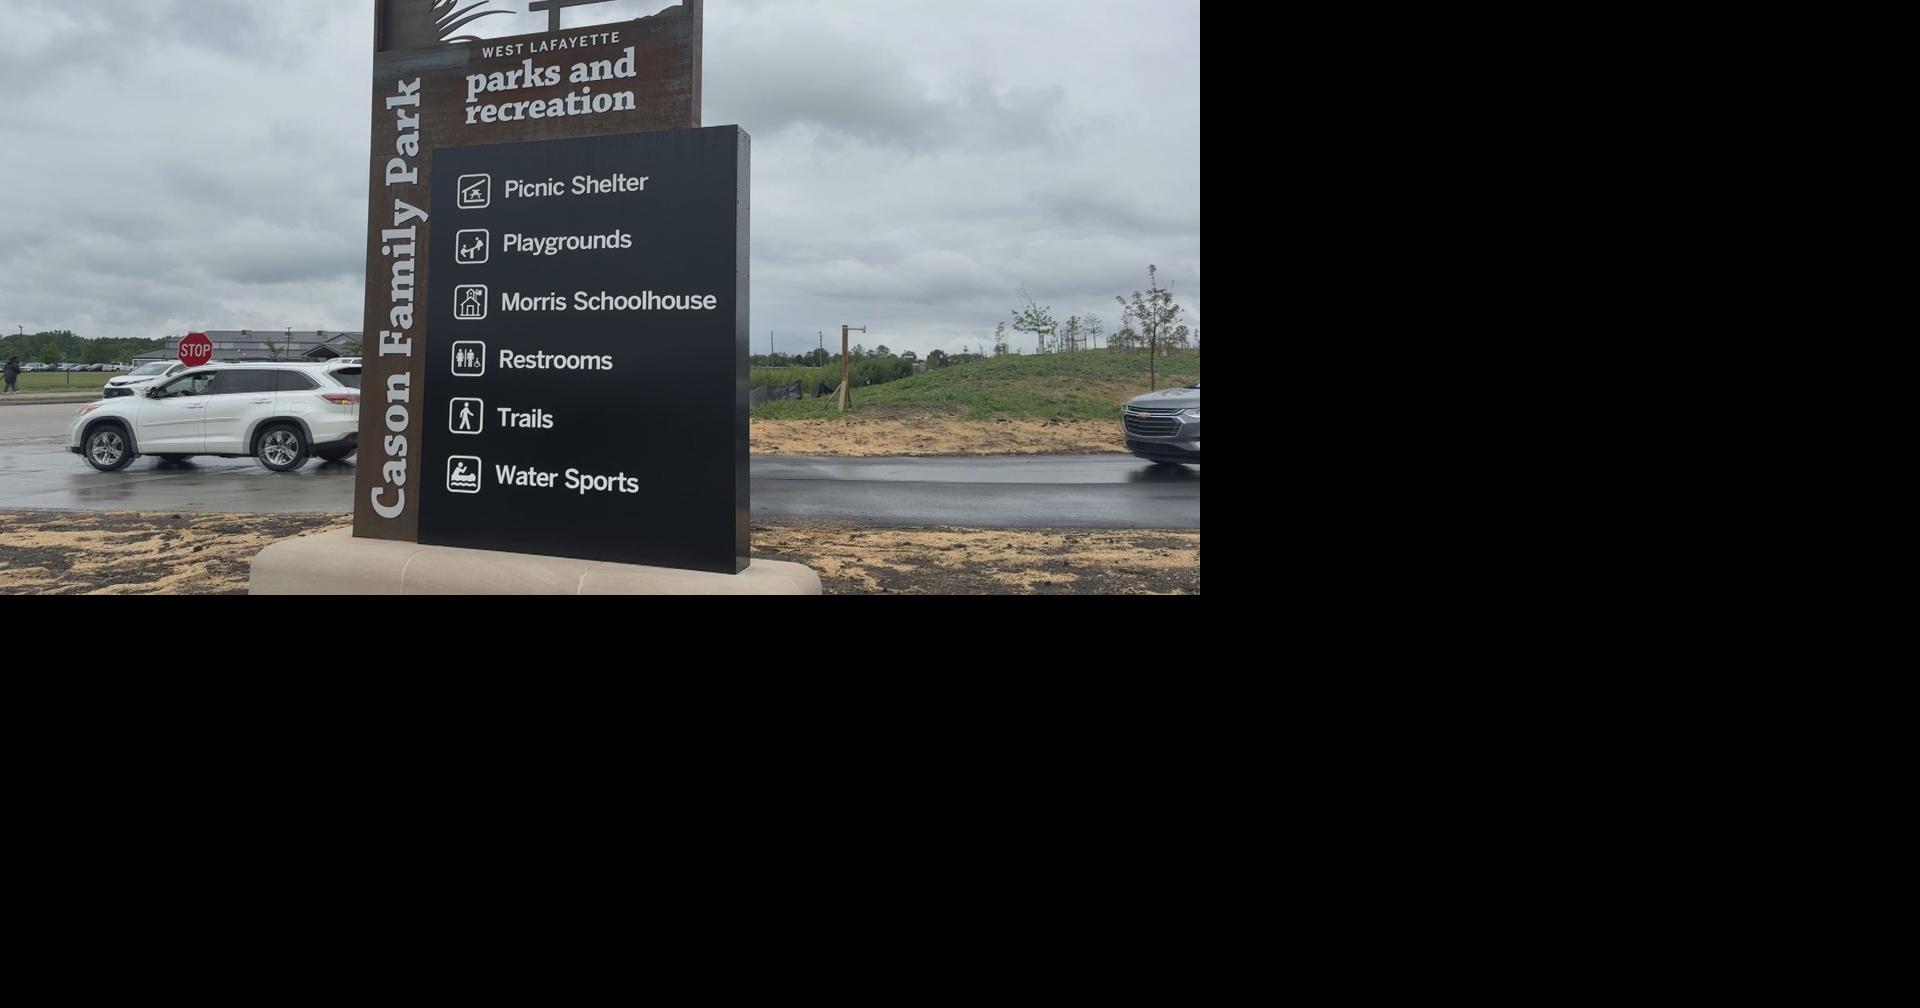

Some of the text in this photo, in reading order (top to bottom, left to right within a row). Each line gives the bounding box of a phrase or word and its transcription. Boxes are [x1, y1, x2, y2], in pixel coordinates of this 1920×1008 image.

[482, 31, 621, 58] WEST LAFAYETTE
[466, 46, 637, 103] parks and
[465, 86, 636, 125] recreation
[504, 172, 649, 199] Picnic Shelter
[503, 229, 632, 256] Playgrounds
[371, 77, 429, 519] Cason Family Park
[501, 290, 717, 312] Morris Schoolhouse
[180, 343, 211, 358] STOP
[499, 349, 613, 371] Restrooms
[497, 407, 554, 429] Trails
[495, 464, 639, 495] Water Sports
